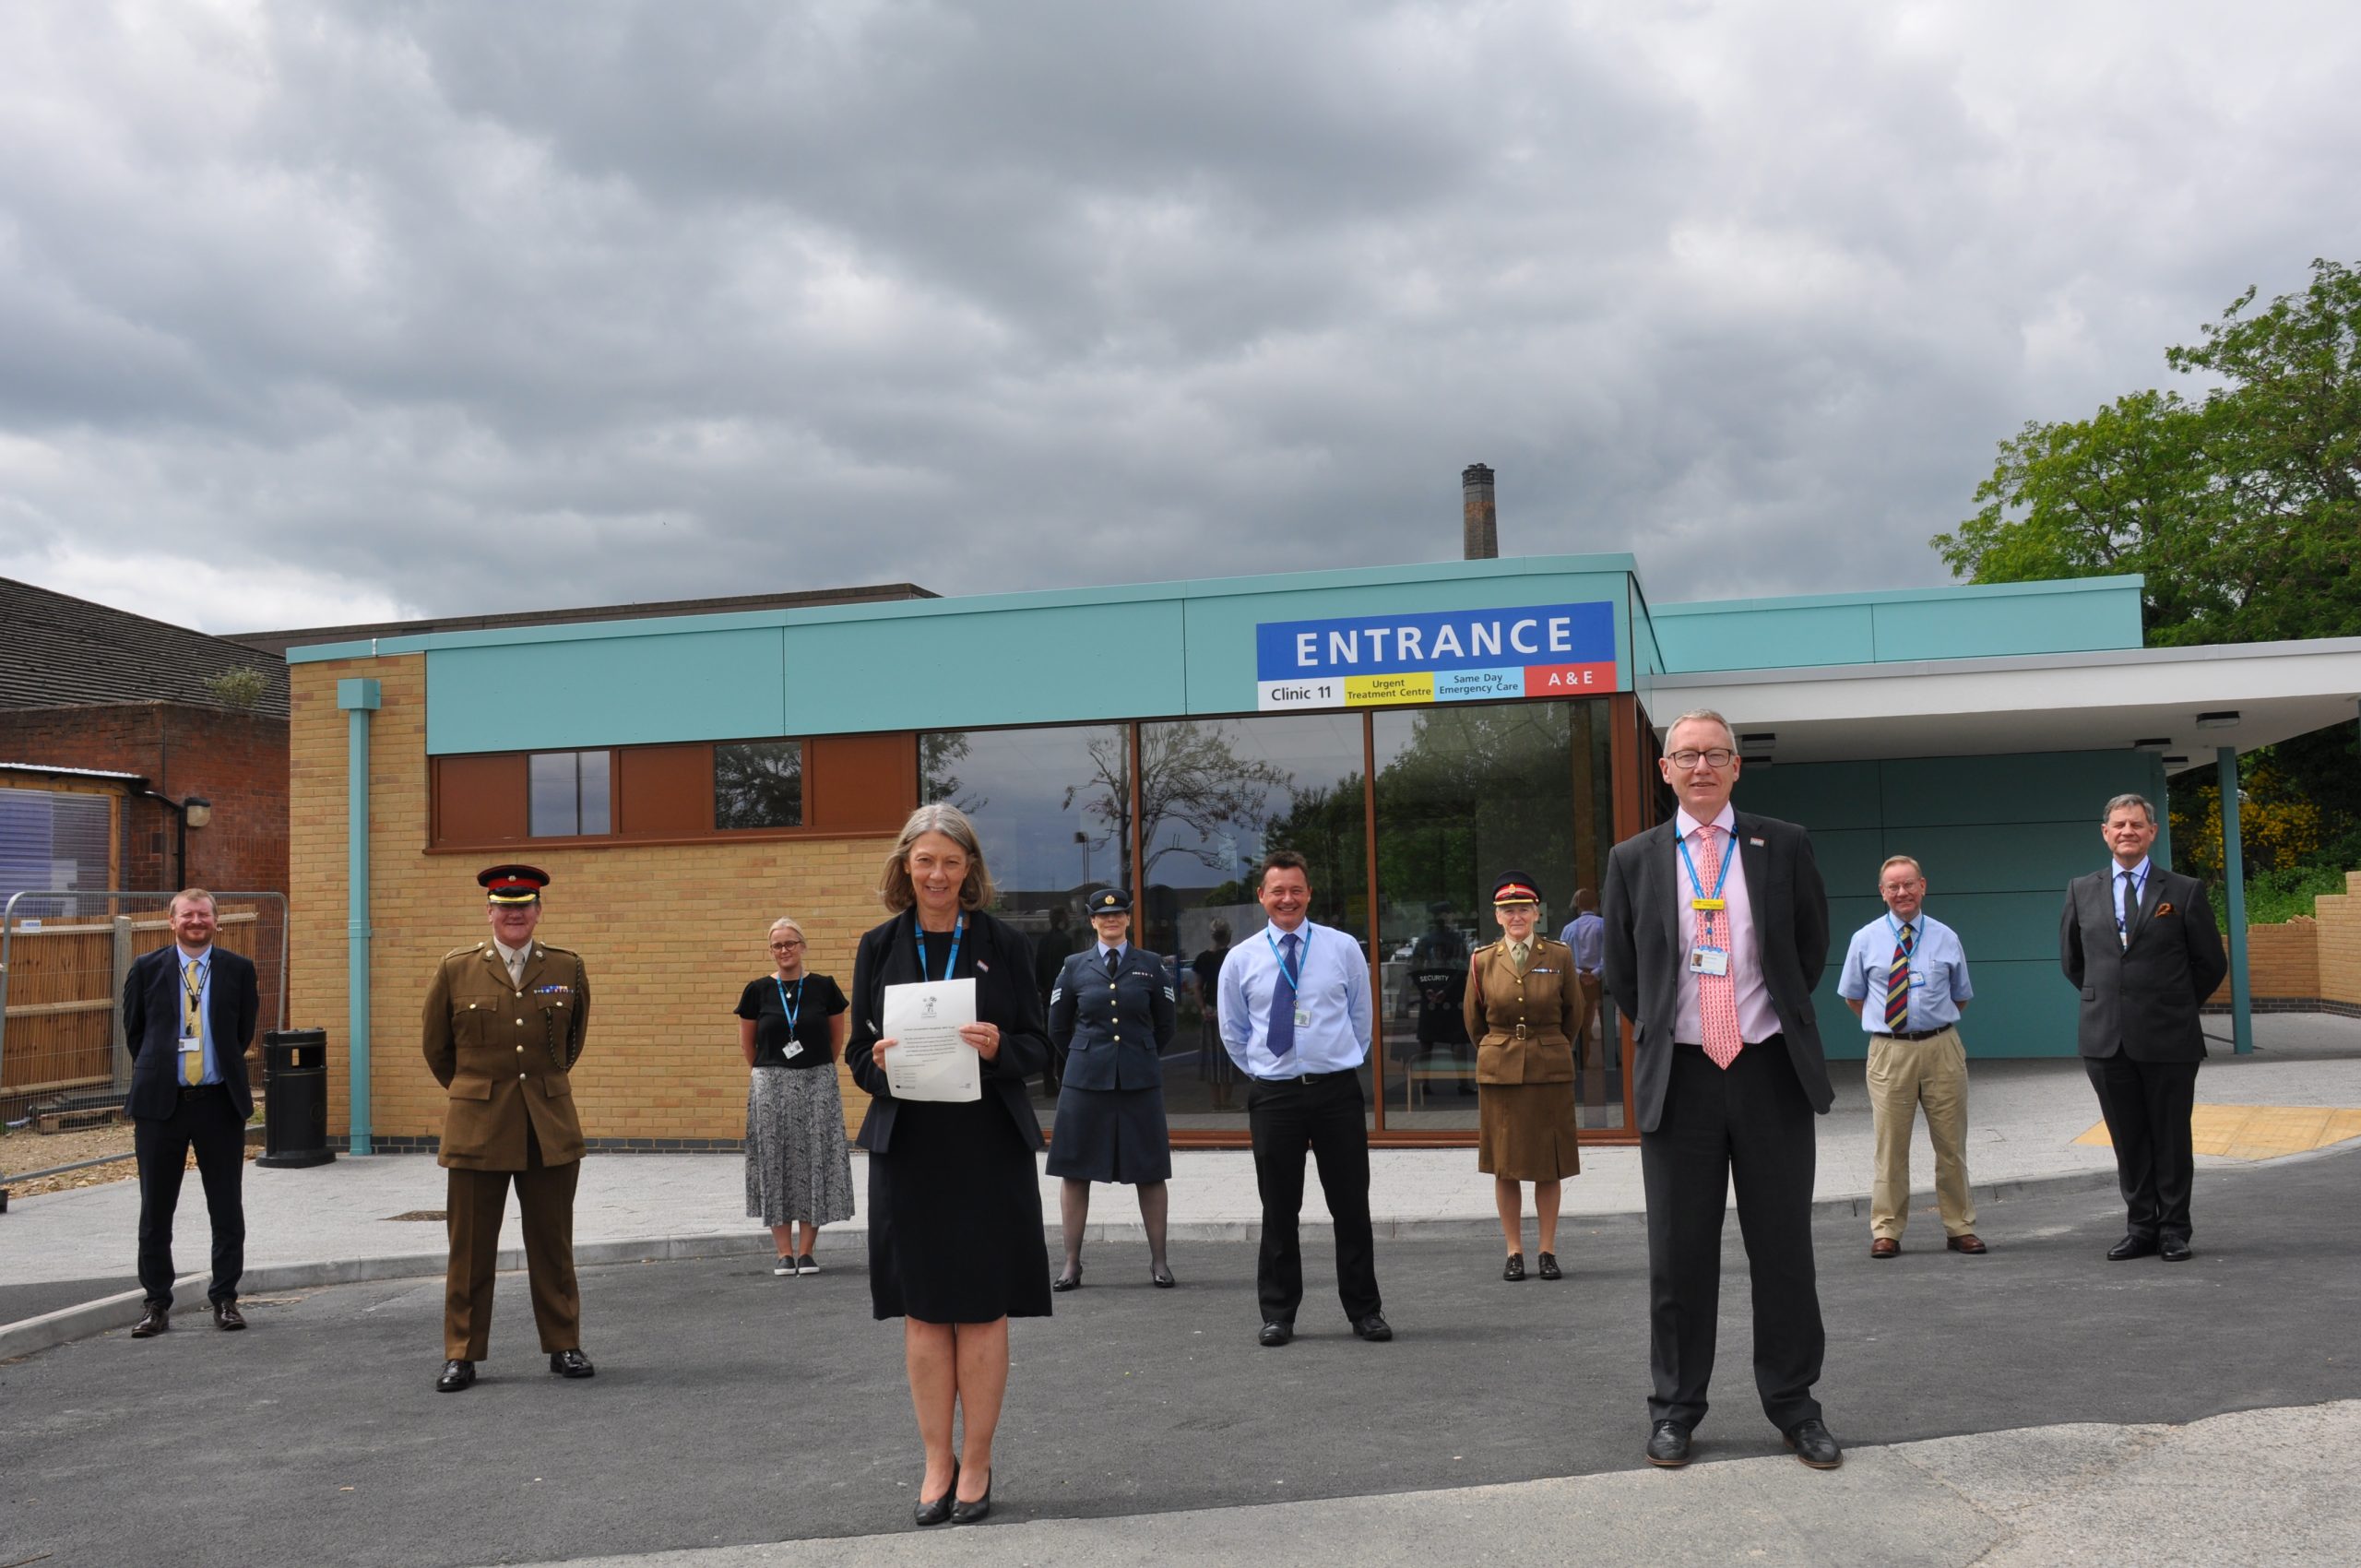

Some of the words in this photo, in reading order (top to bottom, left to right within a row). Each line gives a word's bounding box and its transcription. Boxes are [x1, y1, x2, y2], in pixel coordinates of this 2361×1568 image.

[1296, 617, 1572, 667] ENTRANCE
[1453, 674, 1480, 683] Same
[1484, 673, 1503, 683] Day
[1548, 672, 1561, 686] A
[1566, 671, 1579, 685] &
[1583, 671, 1594, 684] E
[1372, 679, 1406, 690] Urgent
[1440, 684, 1493, 695] Emergency
[1496, 683, 1519, 691] Care
[1271, 686, 1311, 701] Clinic
[1317, 685, 1332, 698] 11
[1347, 689, 1397, 699] Treatment
[1400, 687, 1432, 697] Centre
[1419, 974, 1450, 982] SECURITY
